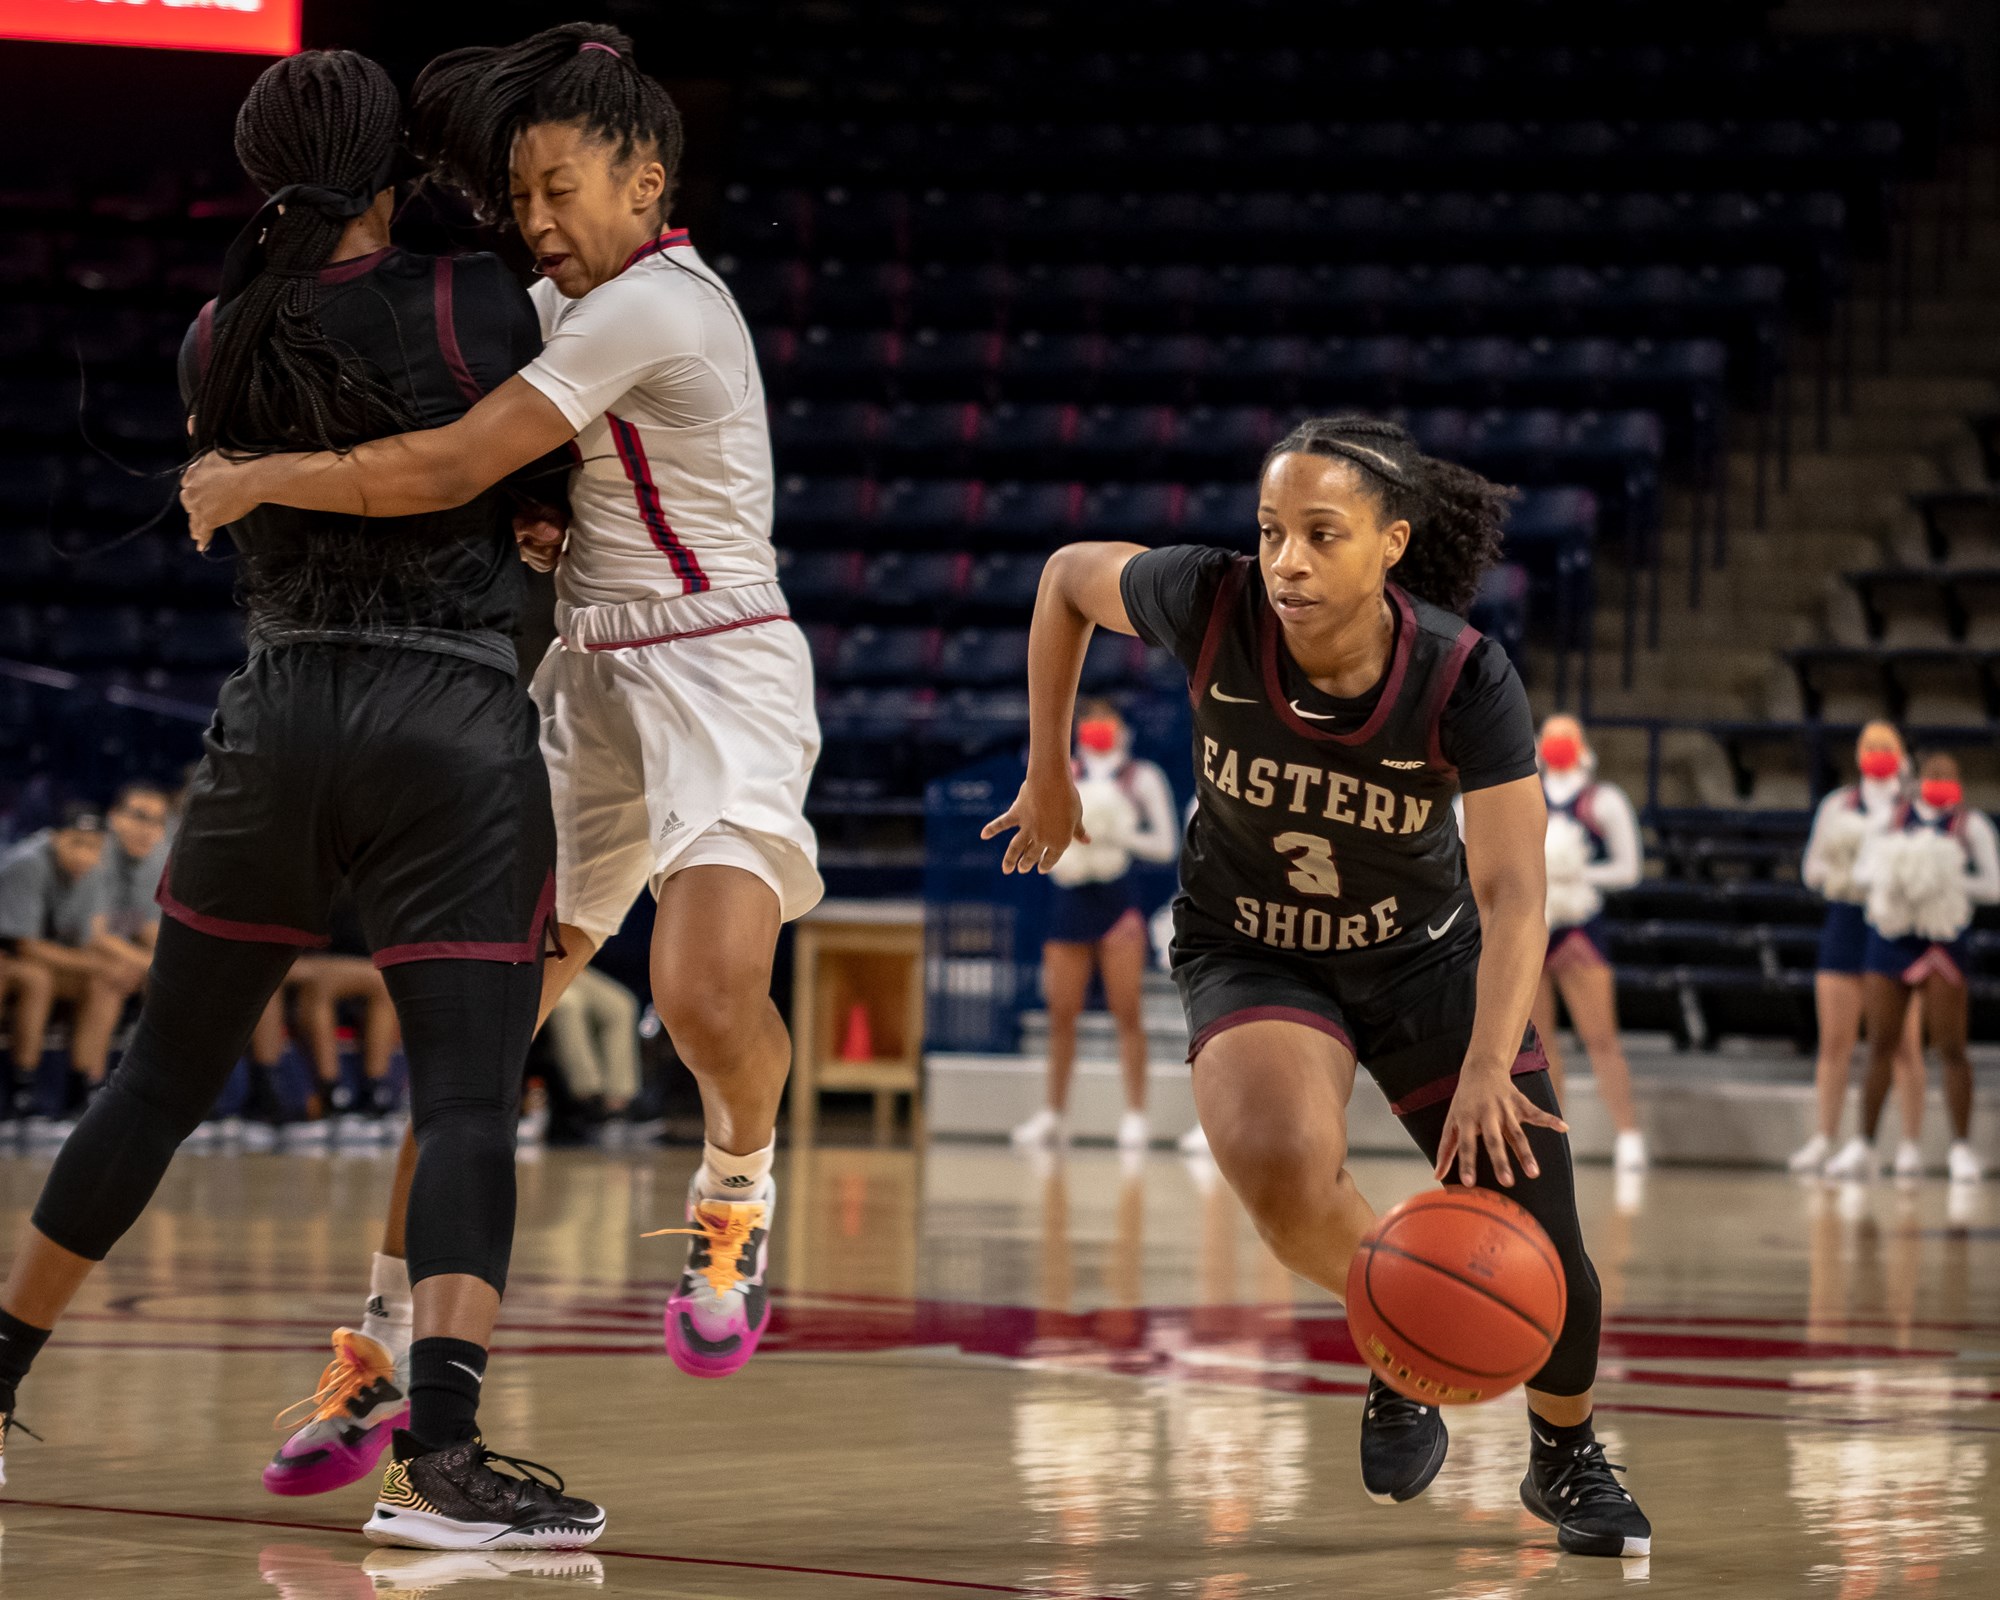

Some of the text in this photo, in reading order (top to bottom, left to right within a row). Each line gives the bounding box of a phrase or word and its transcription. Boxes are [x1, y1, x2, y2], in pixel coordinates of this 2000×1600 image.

[1203, 735, 1433, 835] EASTERN
[1380, 759, 1425, 770] MEAC
[1273, 831, 1341, 898] 3
[1233, 896, 1403, 951] SHORE
